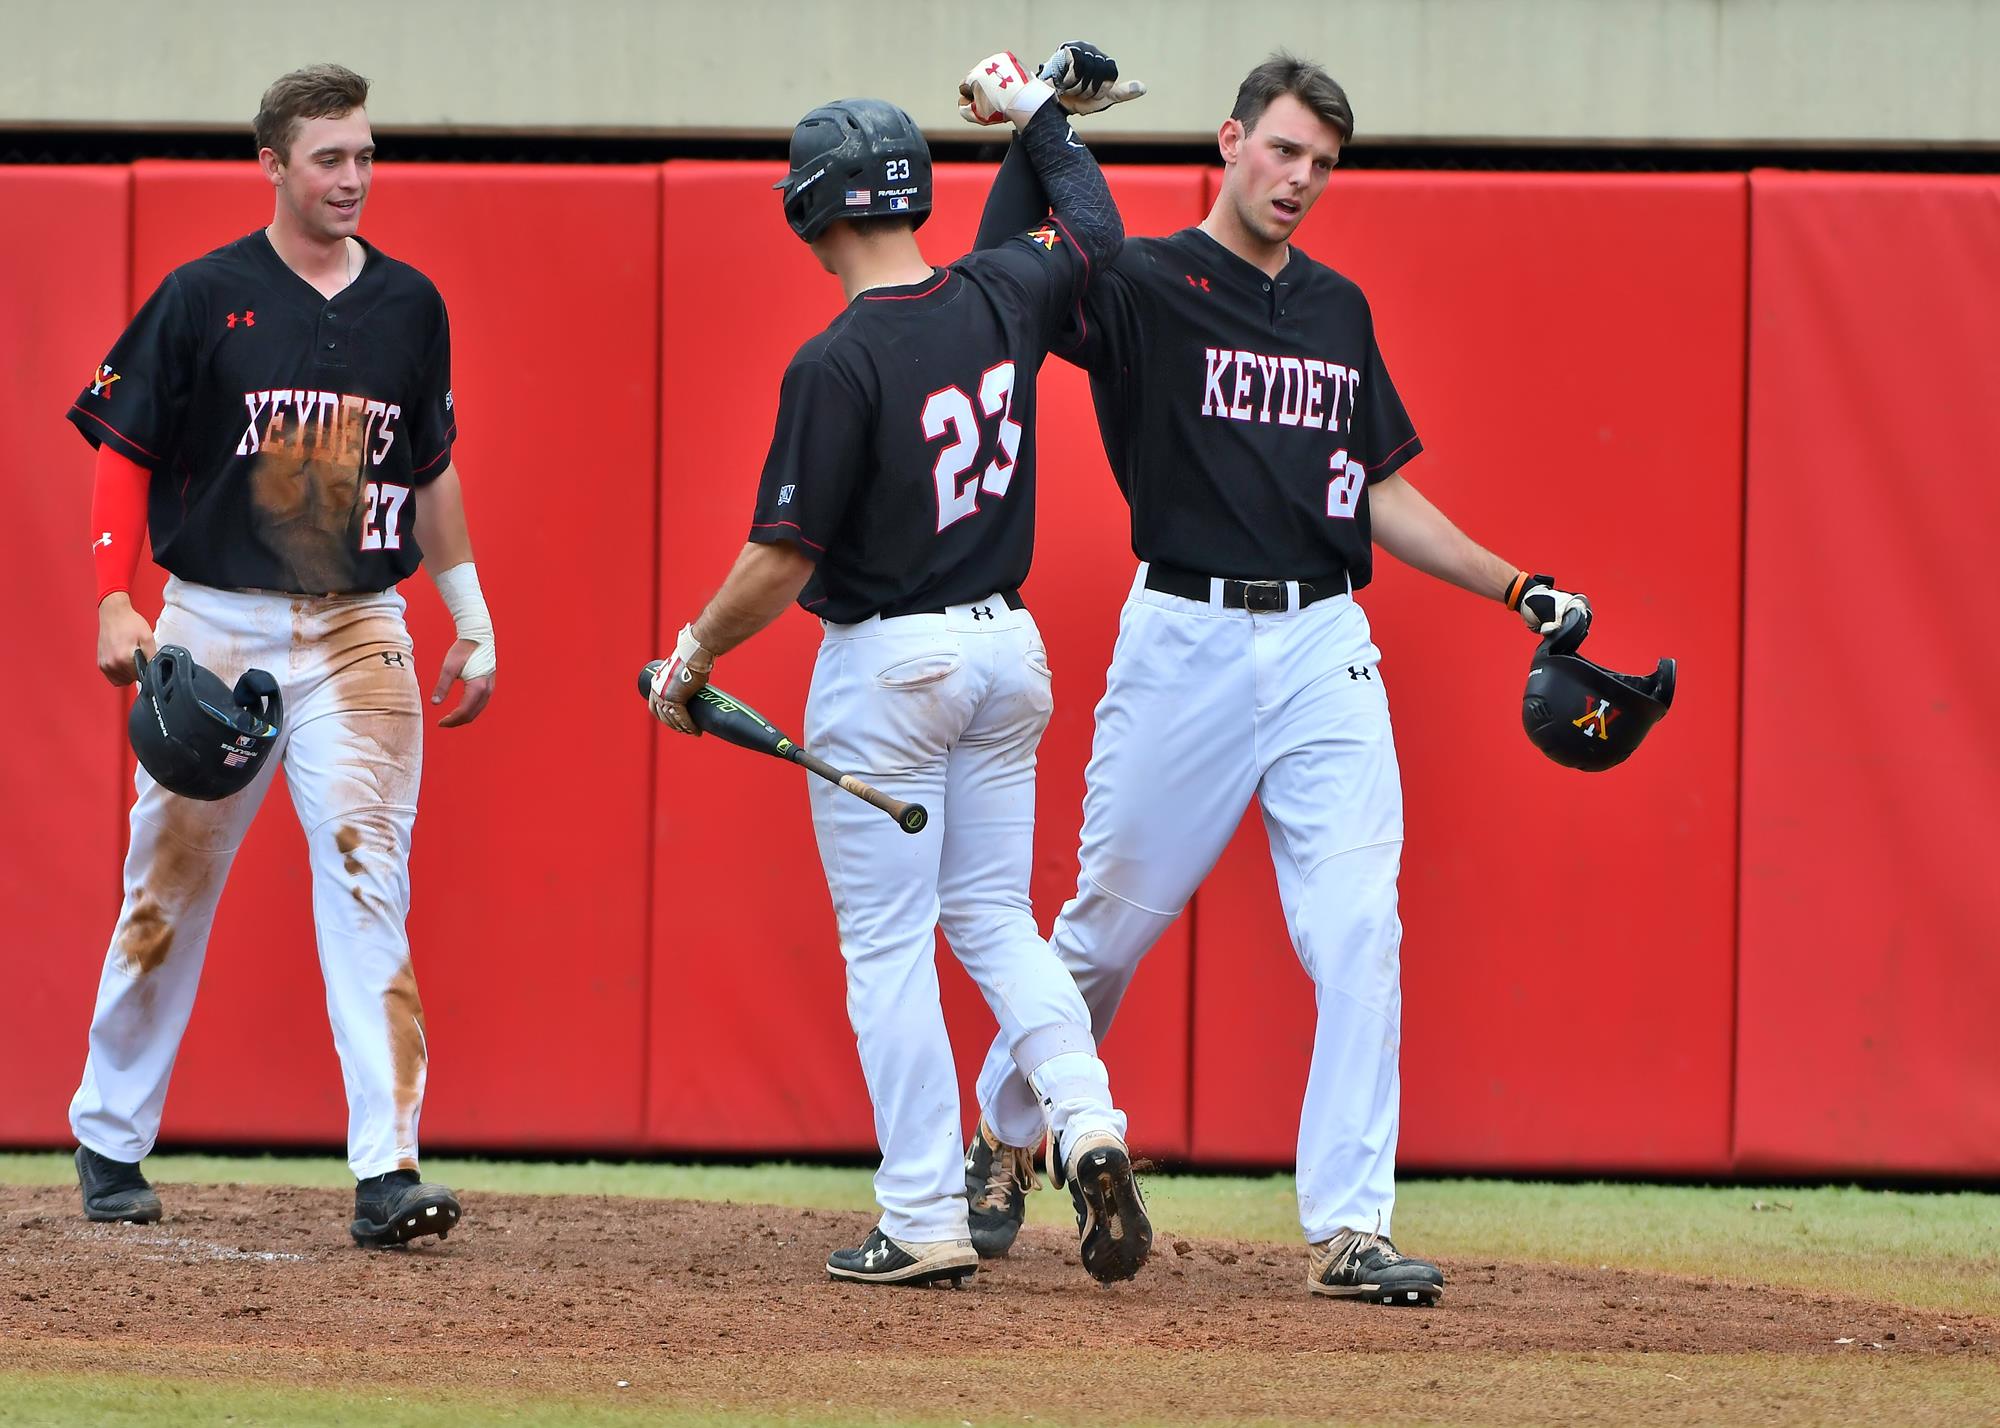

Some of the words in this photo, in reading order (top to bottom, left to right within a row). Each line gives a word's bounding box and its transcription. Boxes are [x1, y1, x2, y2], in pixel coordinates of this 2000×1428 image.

[877, 187, 918, 197] RAWLINGS
[884, 157, 911, 181] 23
[1201, 346, 1361, 435] KEYDETS
[919, 358, 1024, 535] 23
[360, 481, 411, 552] 27
